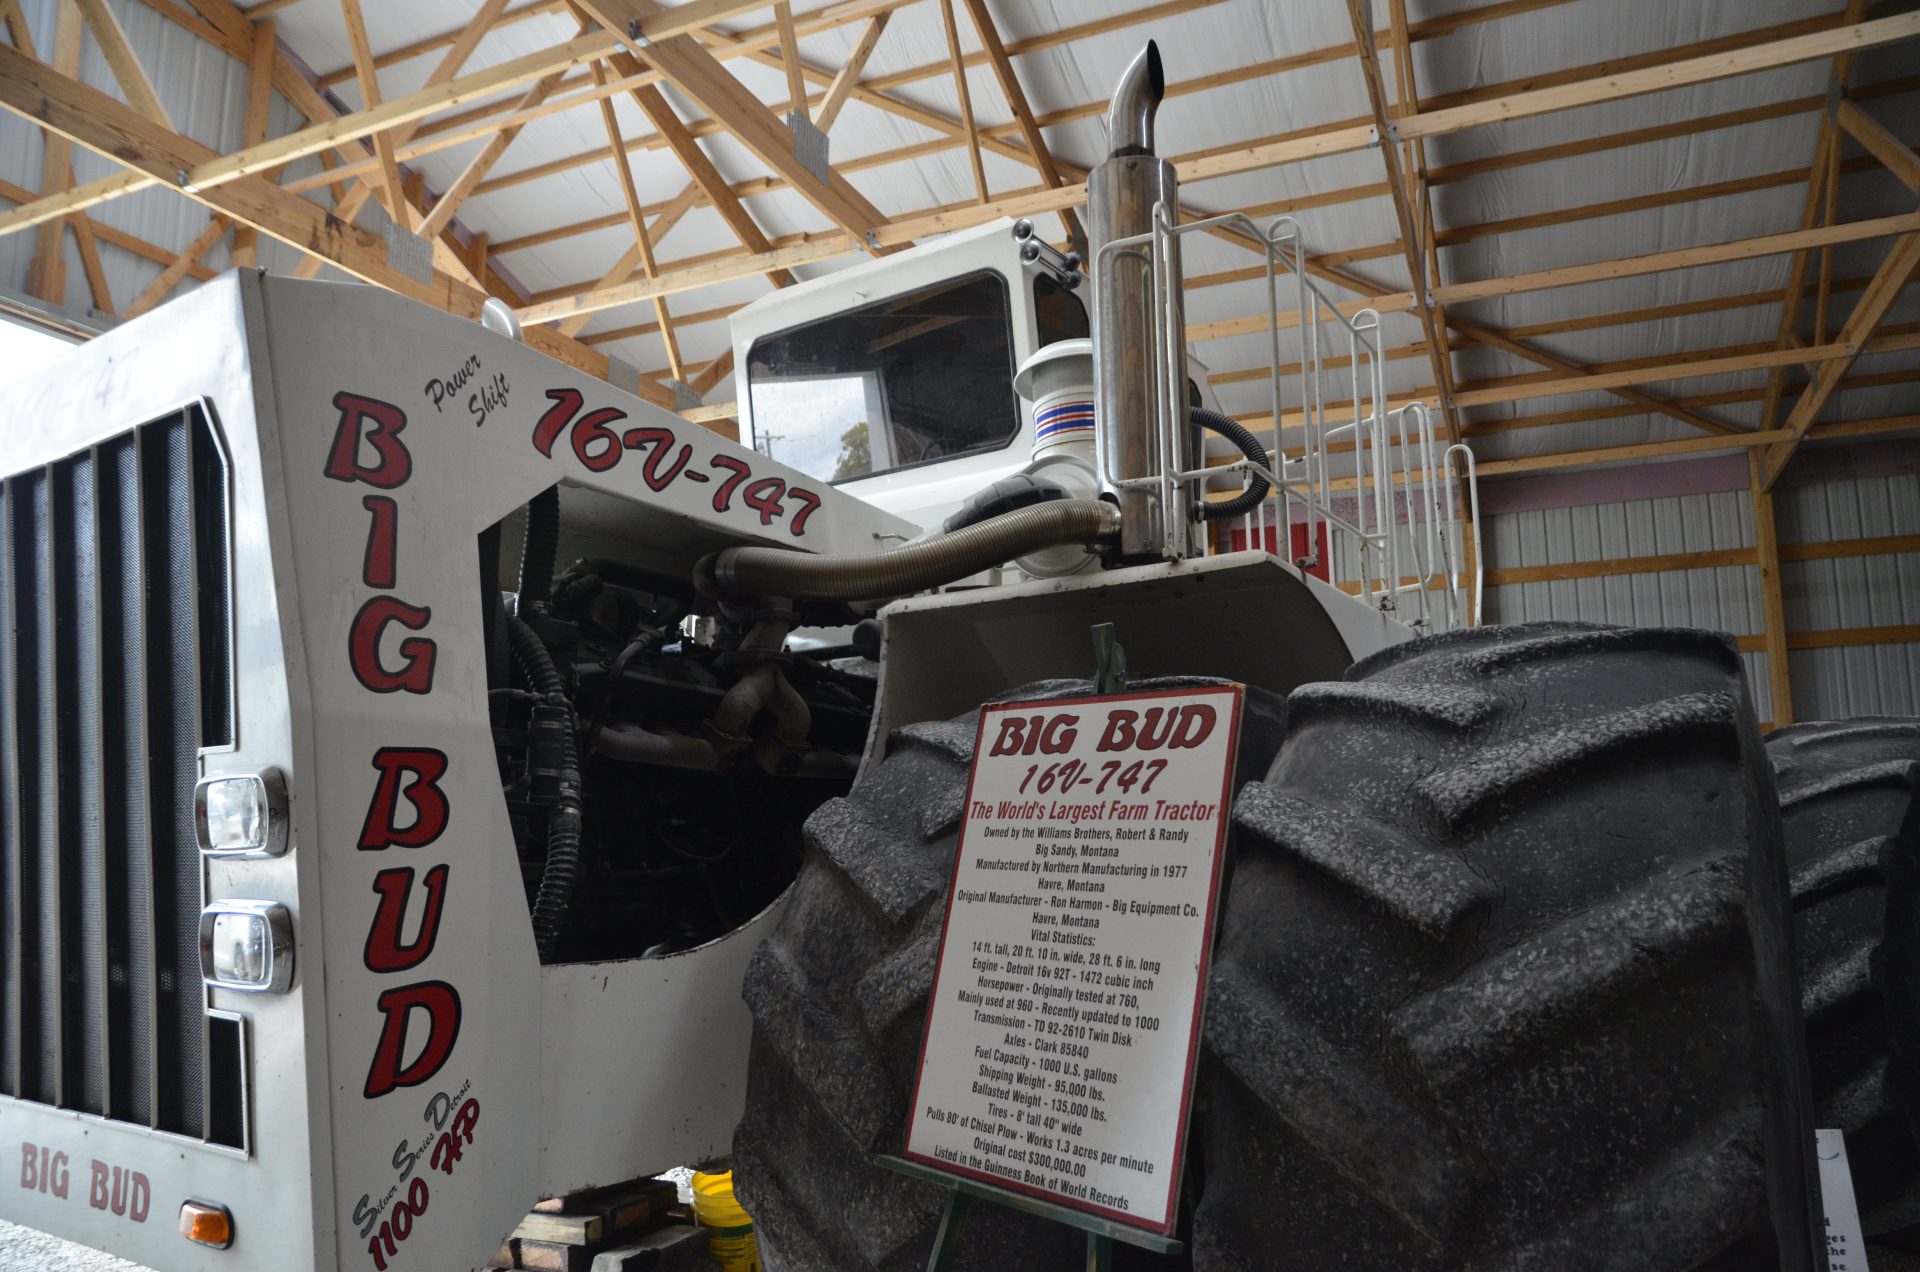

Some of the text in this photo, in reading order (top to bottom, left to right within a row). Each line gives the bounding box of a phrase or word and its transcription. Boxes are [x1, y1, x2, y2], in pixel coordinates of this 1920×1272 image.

[424, 353, 481, 413] Power
[469, 370, 511, 428] Shift
[531, 387, 821, 537] 16V-747
[323, 390, 462, 1100] BIG BUD
[989, 704, 1217, 757] BIG BUD
[1019, 759, 1168, 795] 16V-747
[971, 800, 1215, 823] The World's Largest Farm Tractor
[984, 826, 1189, 843] Owned by the Williams Brothers, Robert & Randy
[1035, 844, 1119, 859] Big Sandy, Montana
[976, 859, 1187, 879] Manufactured by Northern Manufacturing in 1977
[1038, 878, 1105, 892] Havre, Montana
[958, 890, 987, 903] Original
[989, 892, 1042, 906] Manufacturer
[1051, 896, 1067, 908] Ron
[1069, 897, 1103, 910] Harmon
[1112, 899, 1127, 915] Big
[1130, 901, 1180, 917] Equipment
[1183, 904, 1199, 917] Co.
[1032, 912, 1099, 928] Havre, Montana
[1032, 929, 1096, 946] Vital Statistics:
[972, 957, 998, 973] Engine
[1006, 962, 1034, 976] Detroit
[1037, 966, 1052, 978] 16v
[1054, 967, 1071, 981] 92T
[1081, 970, 1102, 984] 1472
[1105, 974, 1130, 988] cubic
[1133, 976, 1153, 991] inch
[973, 941, 1160, 975] 14 ft. tall, 20 ft. 10 in. wide, 28 ft. 6 in. long
[958, 990, 984, 1007] Mainly
[985, 996, 1004, 1007] used
[1006, 998, 1015, 1009] at
[1017, 999, 1033, 1012] 960
[1042, 1002, 1079, 1022] Recently
[1082, 1010, 1119, 1025] updated
[1122, 1014, 1131, 1027] to
[1136, 1016, 1159, 1031] 1000
[978, 975, 1024, 992] Horsepower
[1033, 983, 1073, 1002] Originally
[1076, 989, 1104, 1003] tested
[1106, 993, 1116, 1005] at
[1119, 994, 1139, 1010] 760,
[974, 1010, 1025, 1029] Transmission
[1035, 1019, 1045, 1032] TD
[1048, 1022, 1085, 1039] 92-2610
[1089, 1028, 1109, 1043] Twin
[1112, 1032, 1132, 1047] Disk
[1004, 1033, 1026, 1048] Axles
[1035, 1038, 1058, 1053] Clark
[1060, 1042, 1089, 1059] 85840
[975, 1045, 992, 1060] Fuel
[994, 1049, 1030, 1069] Capacity
[1040, 1058, 1061, 1073] 1000
[1064, 1062, 1080, 1077] U.S.
[1083, 1068, 1117, 1084] gallons
[979, 1064, 1014, 1085] Shipping
[1017, 1072, 1045, 1090] Weight
[1055, 1080, 1087, 1098] 95,000
[1089, 1086, 1105, 1101] lbs.
[972, 1081, 1010, 1100] Ballasted
[1013, 1089, 1041, 1108] Weight
[1052, 1098, 1088, 1118] 135,000
[1091, 1106, 1107, 1122] lbs.
[989, 1103, 1008, 1119] Tires
[1017, 1110, 1025, 1122] 8'
[1027, 1112, 1041, 1127] tall
[1043, 1116, 1059, 1130] 40"
[1062, 1121, 1082, 1136] wide
[352, 1078, 472, 1239] Silver Series Detroit
[927, 1107, 945, 1122] Pulls
[947, 1112, 959, 1125] 80'
[960, 1116, 969, 1127] of
[971, 1117, 995, 1135] Chisel
[997, 1124, 1018, 1140] Plow
[1027, 1131, 1053, 1149] Works
[1057, 1139, 1070, 1153] 1.3
[1072, 1145, 1098, 1160] acres
[1101, 1152, 1117, 1165] per
[1119, 1155, 1154, 1174] minute
[974, 1137, 1086, 1178] Original cost $300,000.00
[20, 1142, 151, 1223] BIG BUD
[368, 1097, 480, 1272] 1100 HP
[934, 1145, 1128, 1210] Listed in the Guinness Book of World Records
